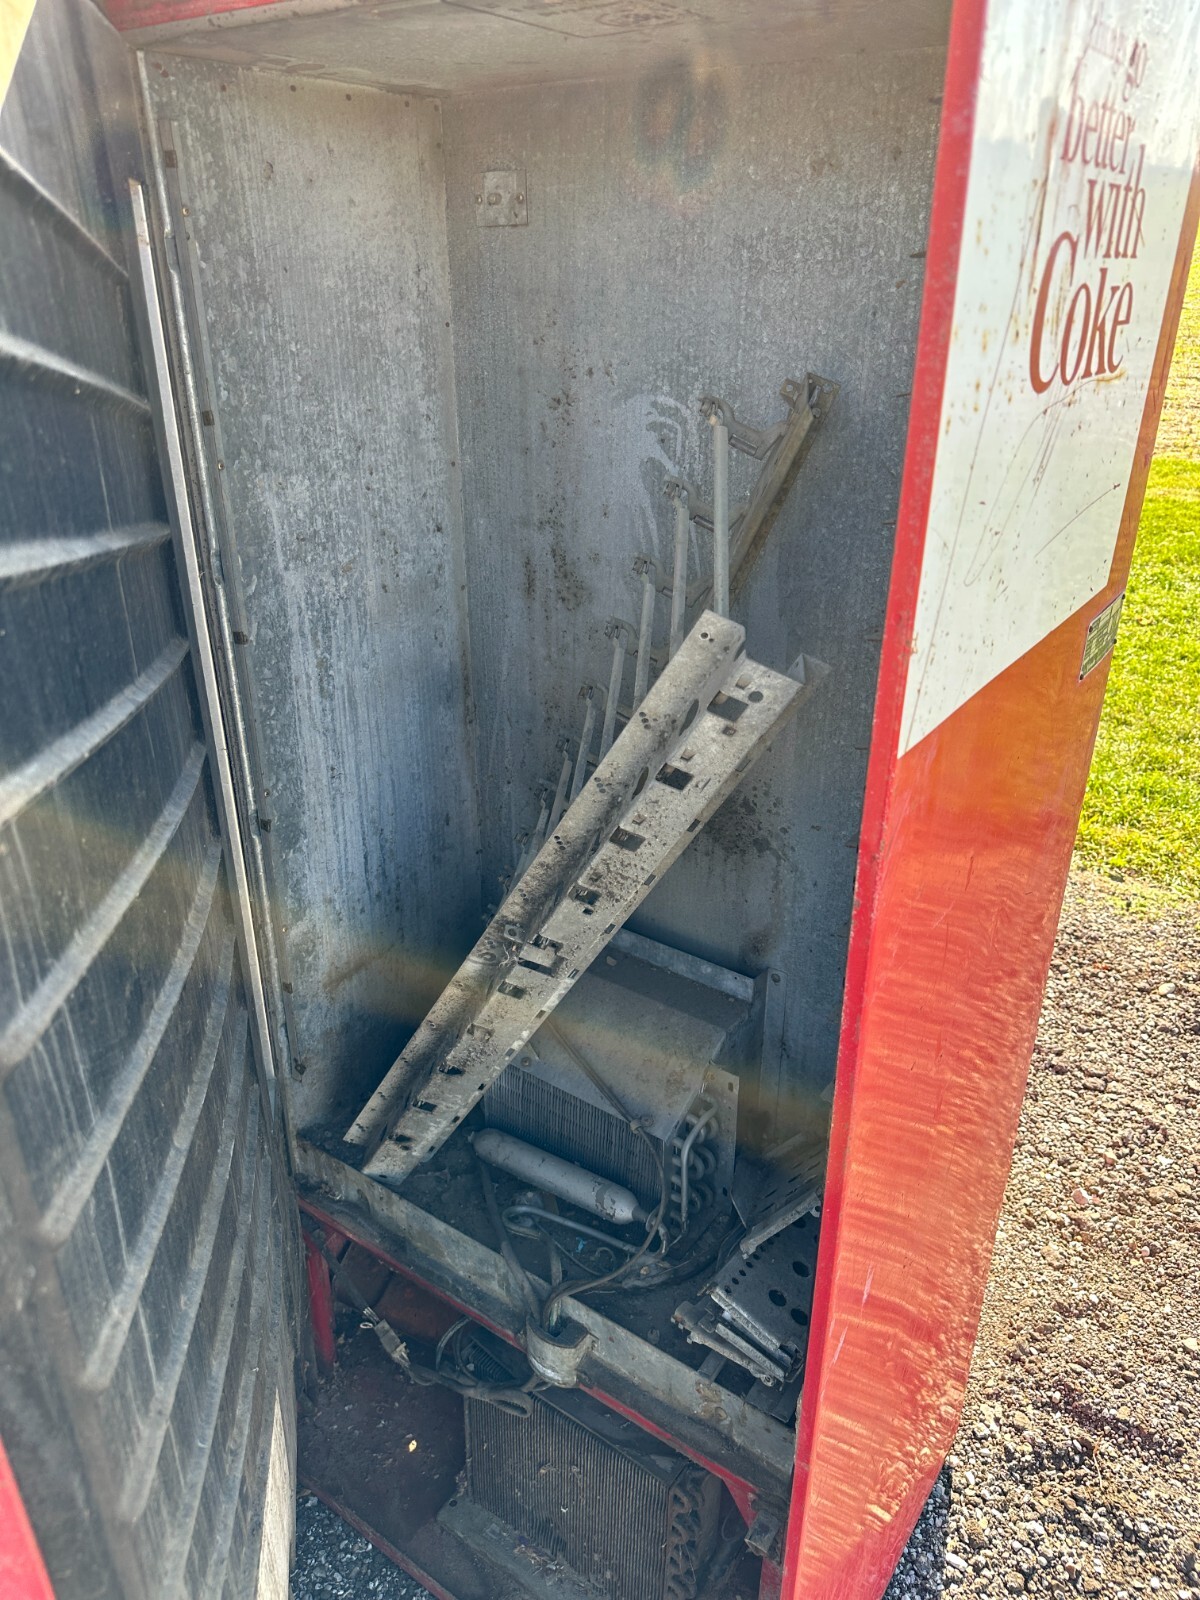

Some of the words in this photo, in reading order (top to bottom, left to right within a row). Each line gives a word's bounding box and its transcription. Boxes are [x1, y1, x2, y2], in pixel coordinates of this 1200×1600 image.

[1060, 57, 1136, 175] better
[1084, 143, 1147, 260] with
[1028, 230, 1134, 395] Coke
